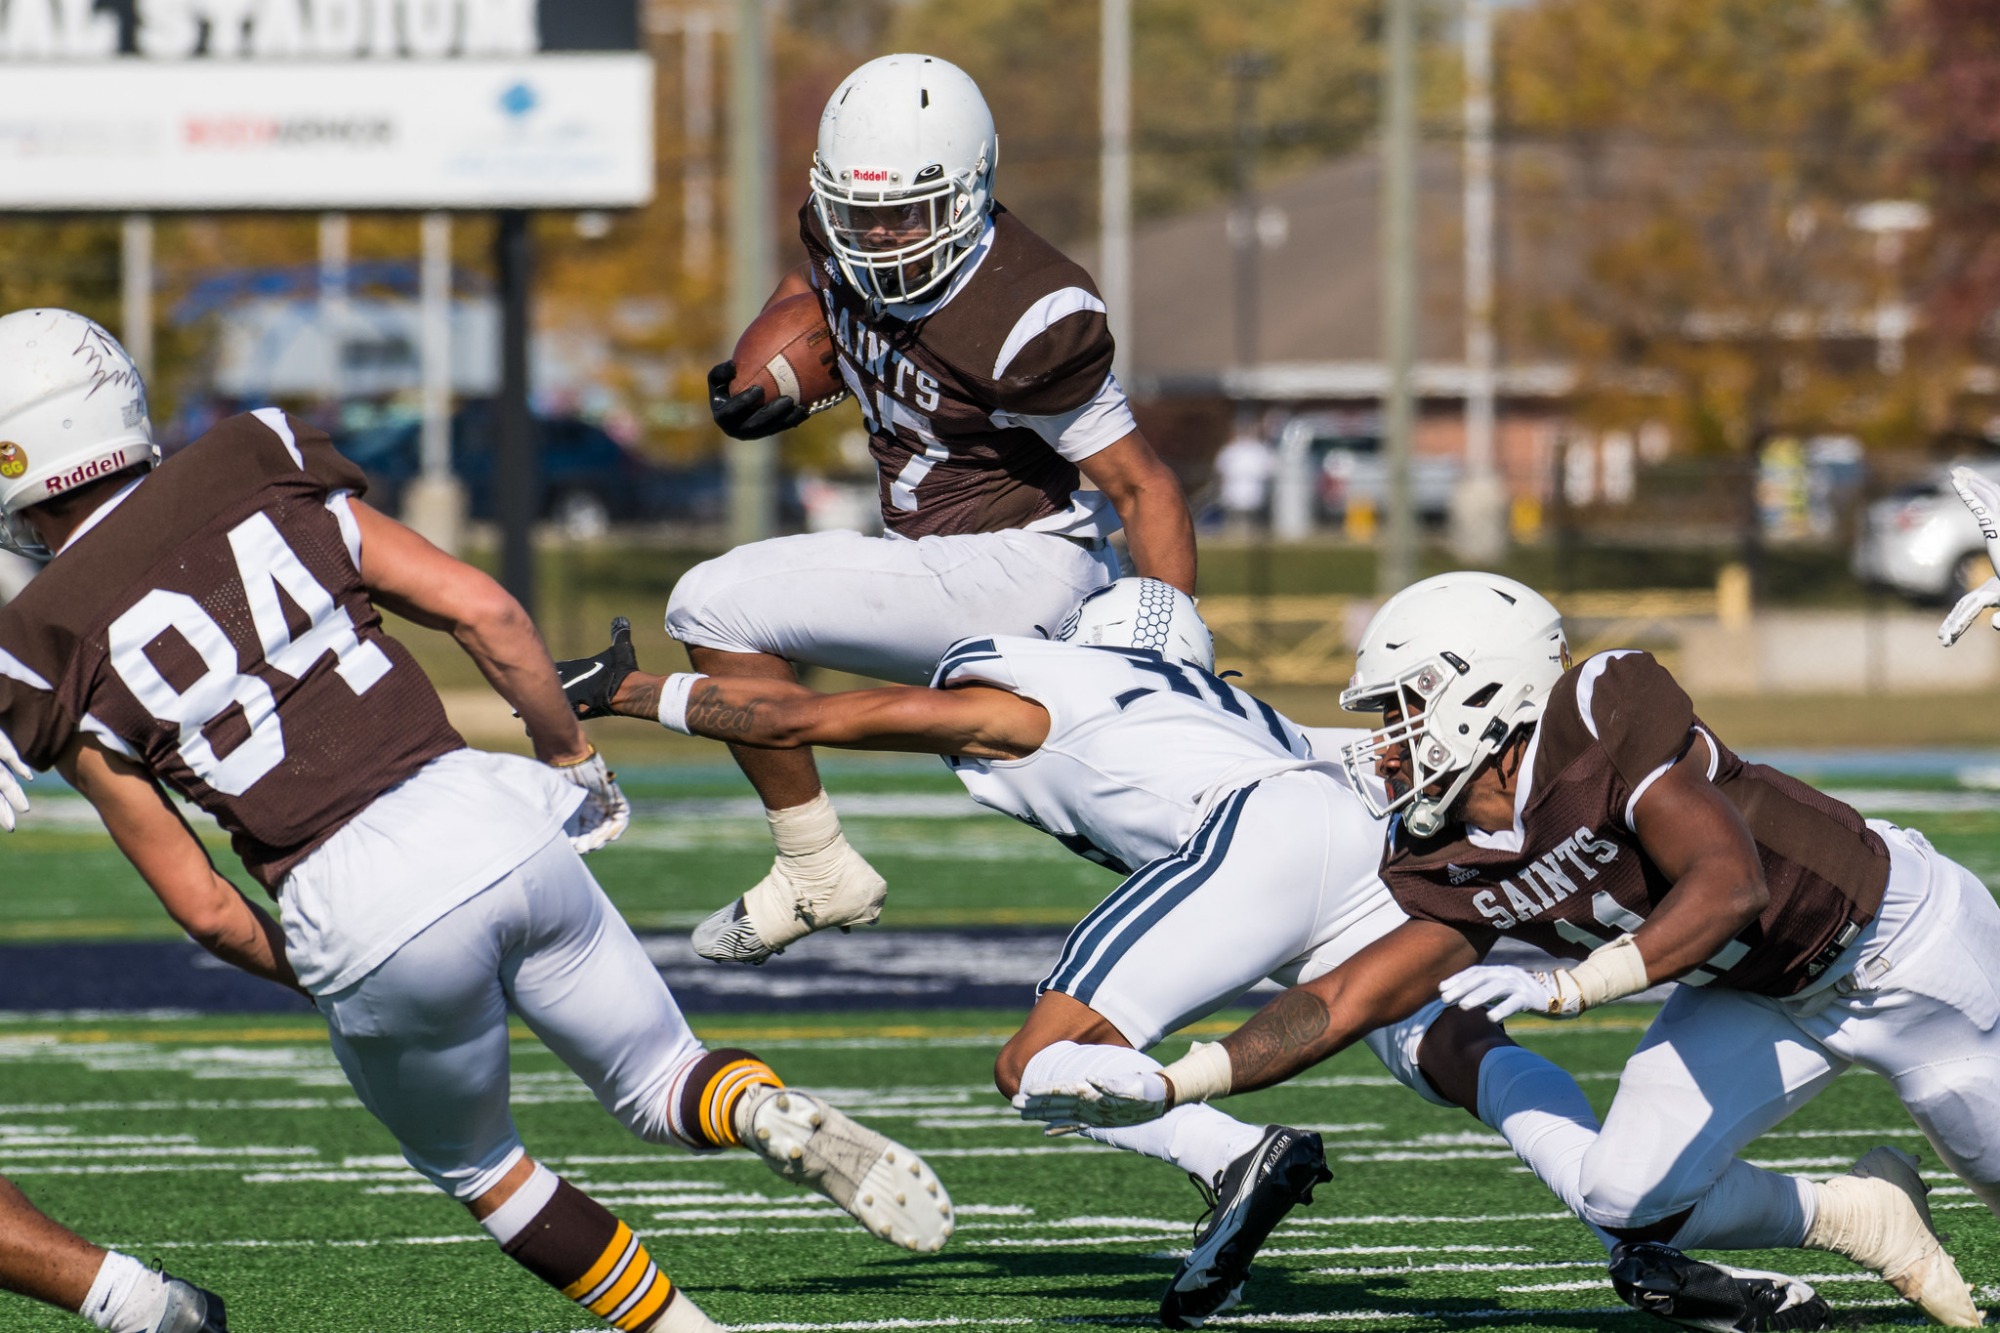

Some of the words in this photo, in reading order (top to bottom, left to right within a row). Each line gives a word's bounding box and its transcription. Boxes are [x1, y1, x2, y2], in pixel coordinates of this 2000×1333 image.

[853, 169, 887, 181] Riddell
[822, 288, 940, 412] SAINTS
[0, 459, 25, 477] GG
[45, 450, 127, 494] Riddell
[107, 510, 394, 797] 84
[1472, 825, 1619, 930] SAINTS
